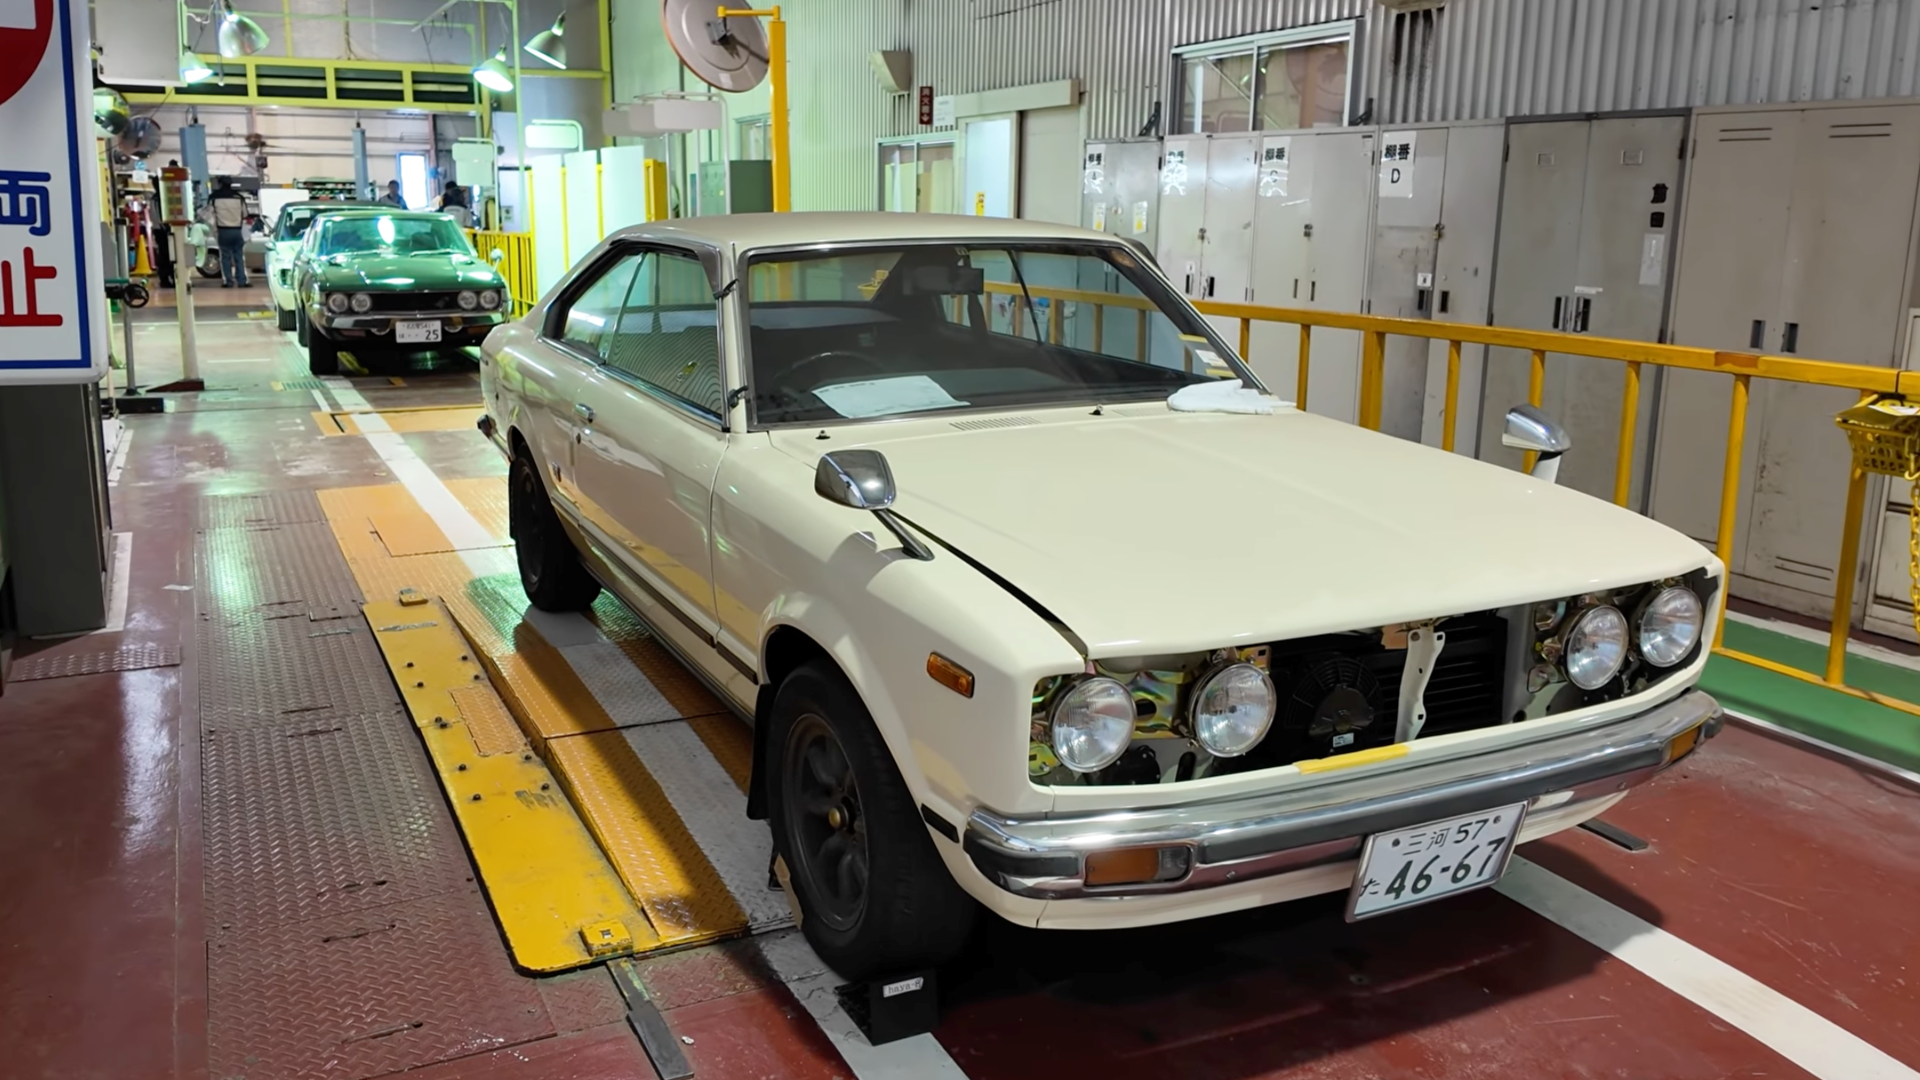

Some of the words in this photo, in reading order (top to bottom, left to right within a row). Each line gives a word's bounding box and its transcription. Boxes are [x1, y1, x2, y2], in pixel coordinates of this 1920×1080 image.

[1390, 168, 1401, 184] D
[0, 246, 64, 327] 止
[425, 329, 439, 340] 25
[1384, 836, 1507, 900] 46-67
